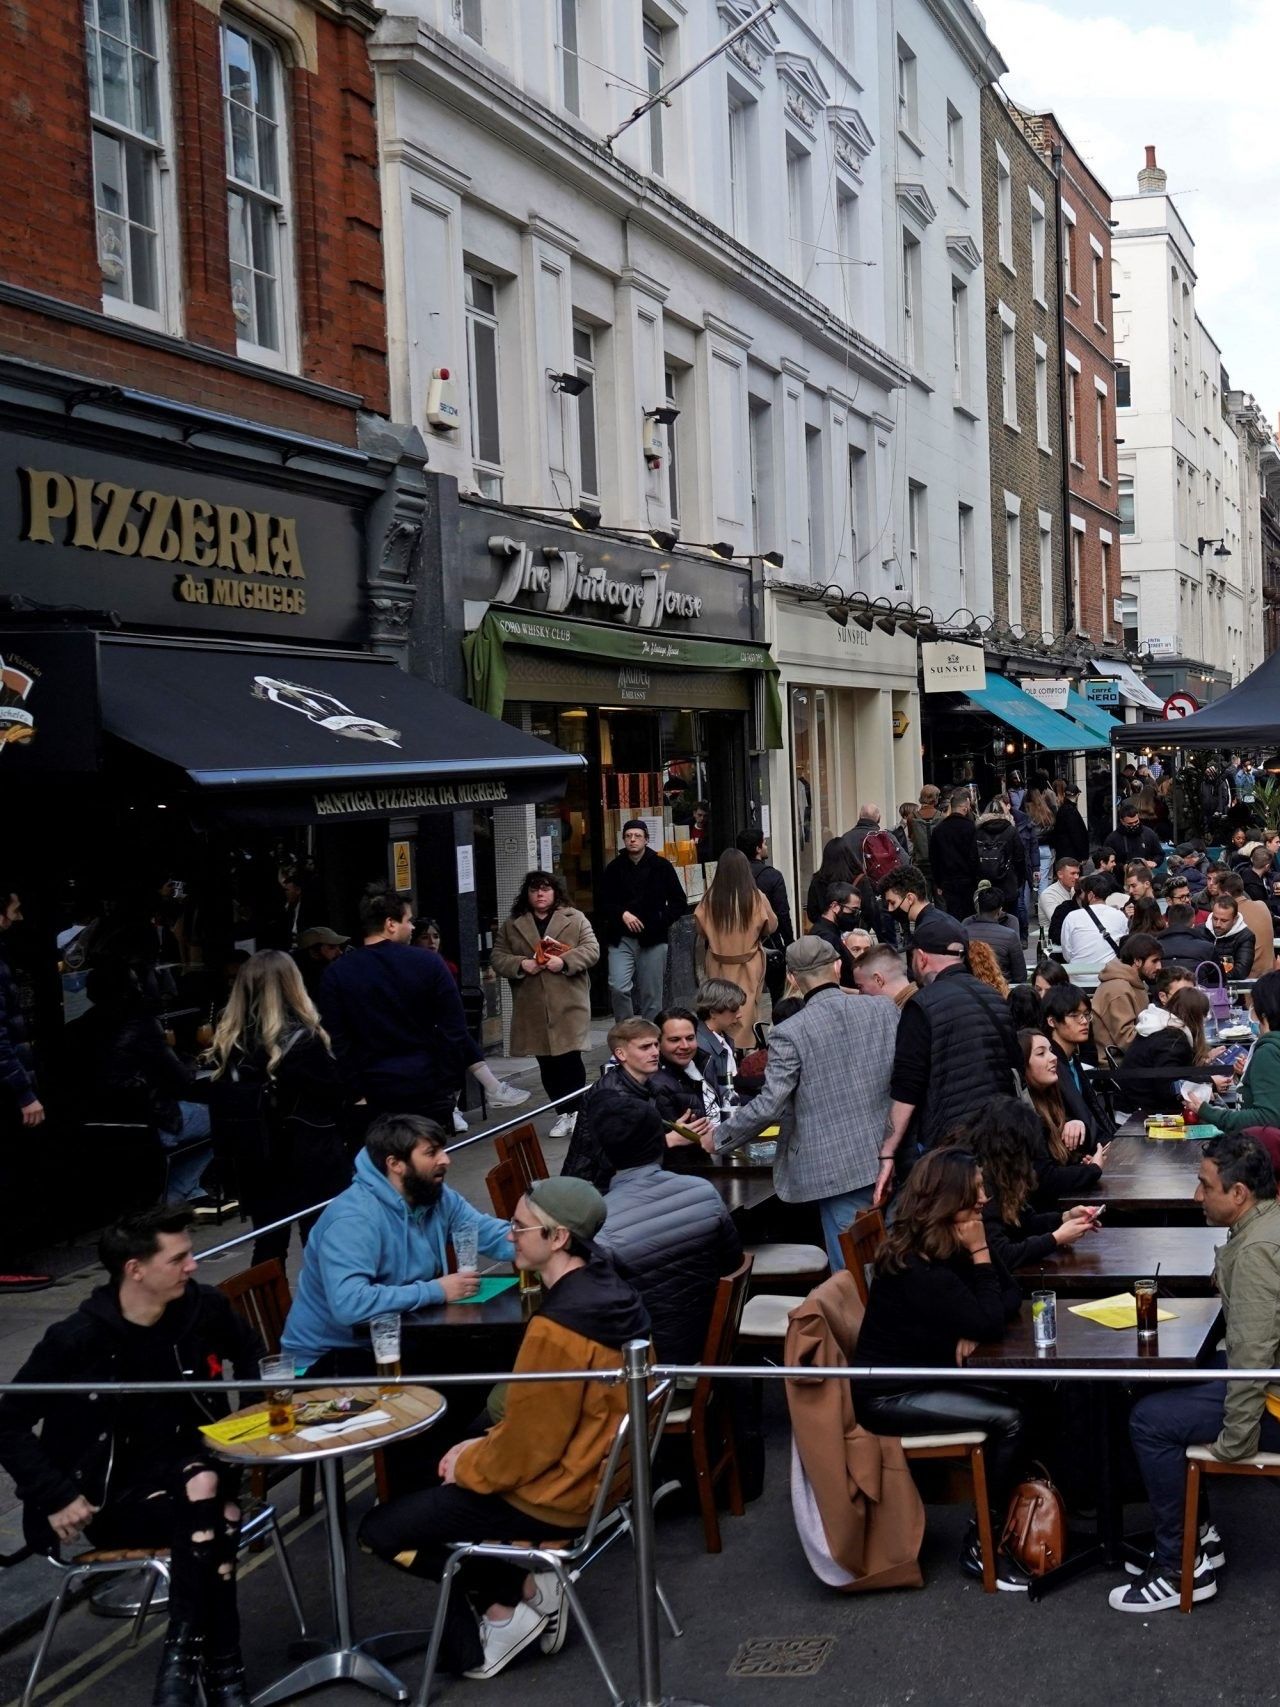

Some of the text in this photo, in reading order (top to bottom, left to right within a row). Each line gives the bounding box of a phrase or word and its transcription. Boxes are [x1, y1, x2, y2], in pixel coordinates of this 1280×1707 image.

[24, 466, 305, 579] PIZZERIA
[178, 574, 208, 604] da
[488, 535, 703, 627] The Vintage House
[500, 620, 571, 641] SOHO WHISKY CLUB
[837, 627, 869, 646] SUNSPEL
[930, 665, 977, 674] SUNSPEL
[1038, 687, 1067, 695] COMPTON
[1087, 693, 1117, 701] NERO
[376, 785, 439, 809] PIZZERIA
